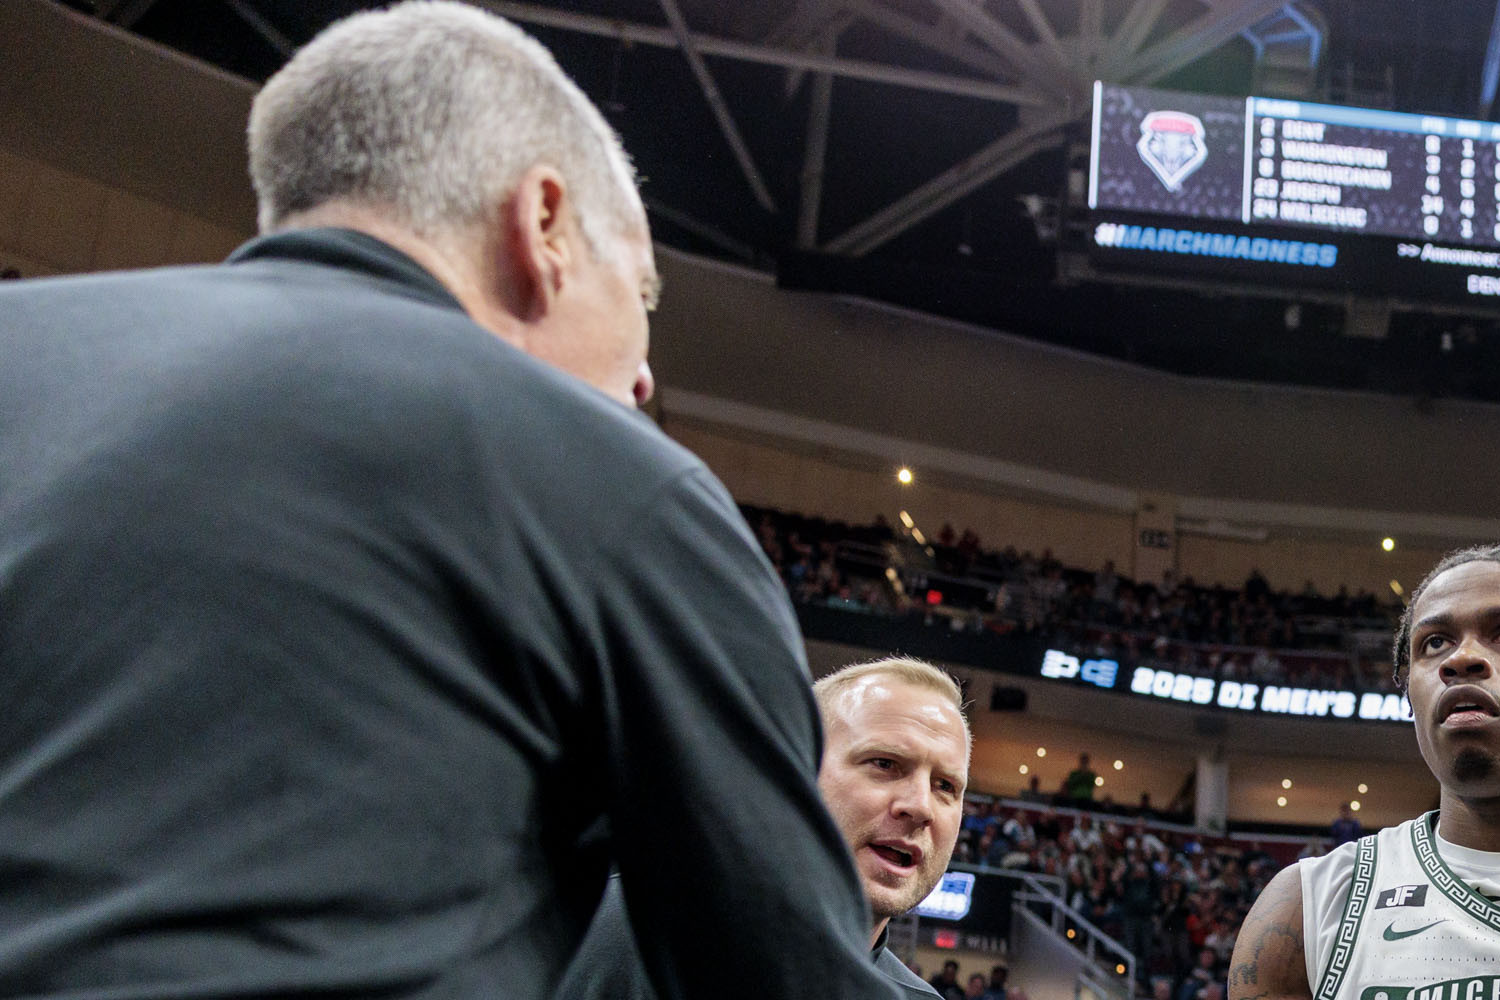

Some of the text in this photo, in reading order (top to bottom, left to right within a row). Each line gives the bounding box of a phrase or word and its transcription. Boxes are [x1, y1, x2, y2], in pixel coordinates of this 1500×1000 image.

[1131, 666, 1216, 704] 2025
[1261, 685, 1357, 719] MEN'S
[1385, 885, 1418, 907] JF
